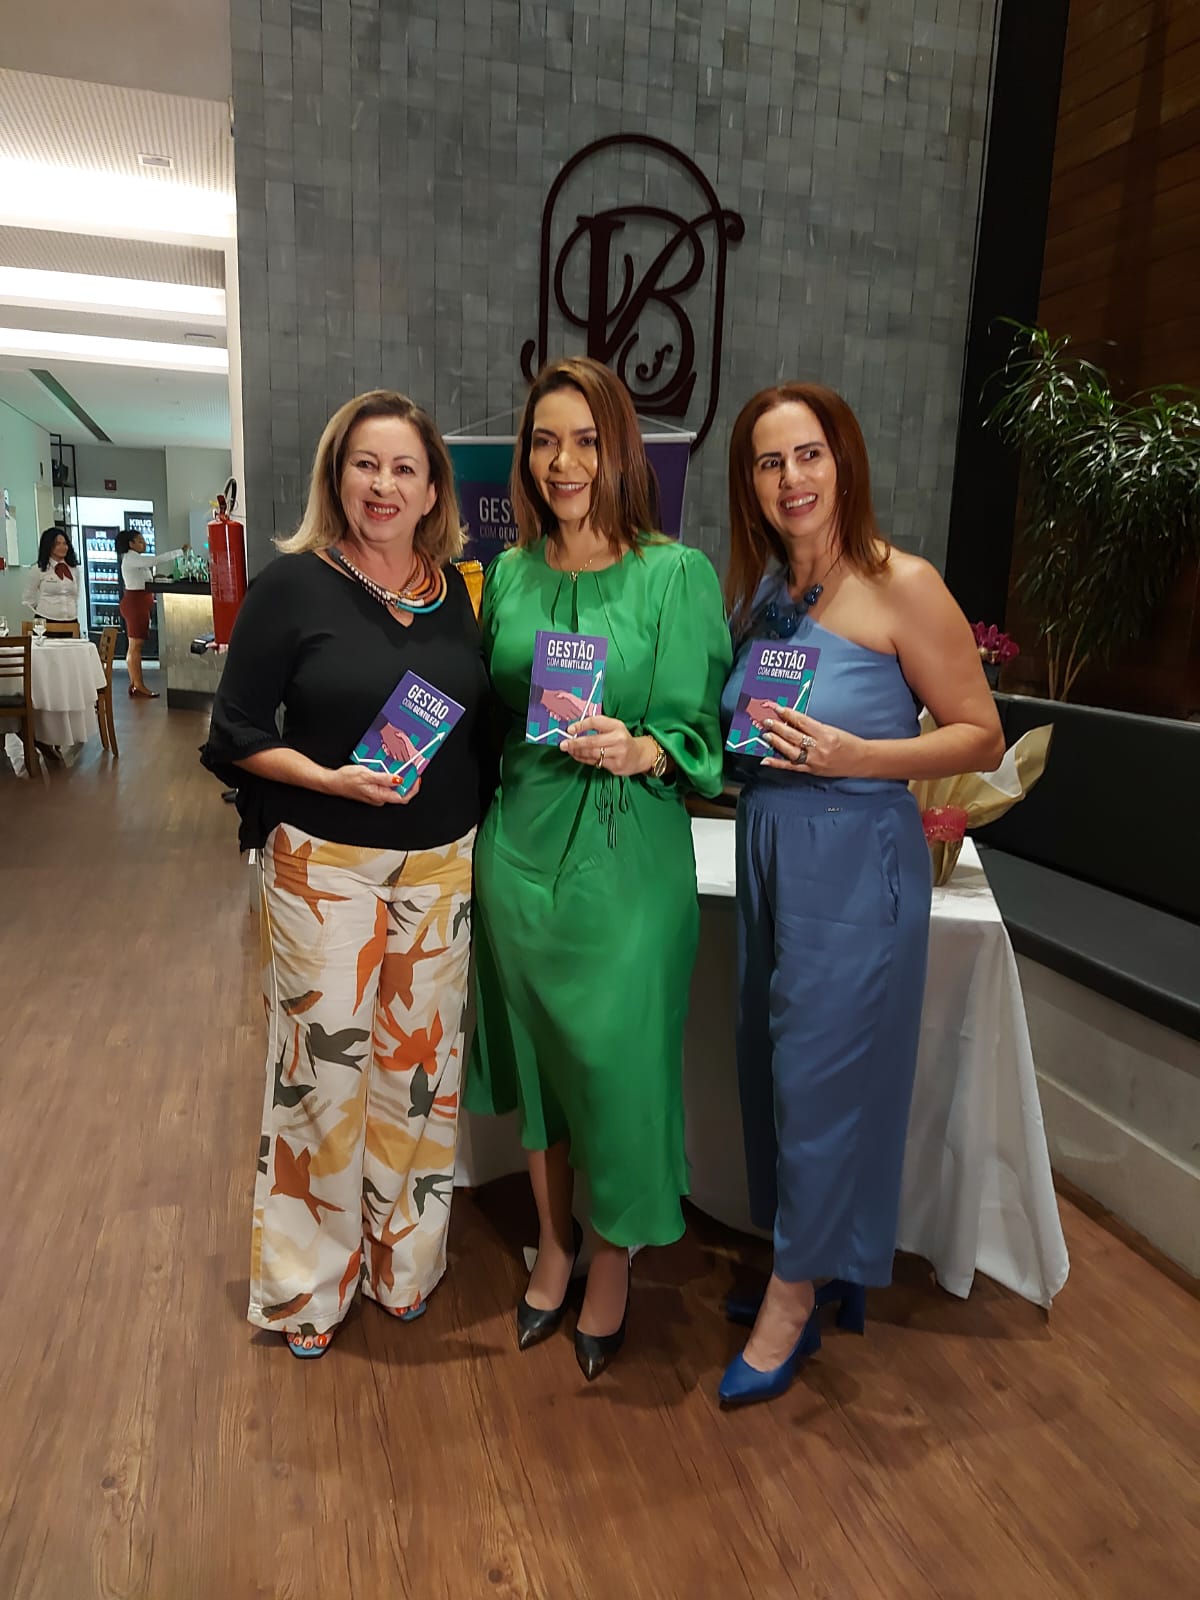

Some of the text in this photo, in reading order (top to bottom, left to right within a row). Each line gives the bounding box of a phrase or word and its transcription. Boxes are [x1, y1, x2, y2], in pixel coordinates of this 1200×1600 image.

[479, 496, 511, 524] GES
[129, 518, 152, 527] KRUG
[480, 526, 497, 538] COM
[547, 639, 595, 661] GESTÃO
[760, 649, 806, 670] GESTÃO
[546, 657, 593, 671] COM GENTILEZA
[757, 666, 802, 680] COM GENTILEZA
[407, 684, 449, 720] GESTÃO
[401, 697, 440, 729] COM GENTILEZA
